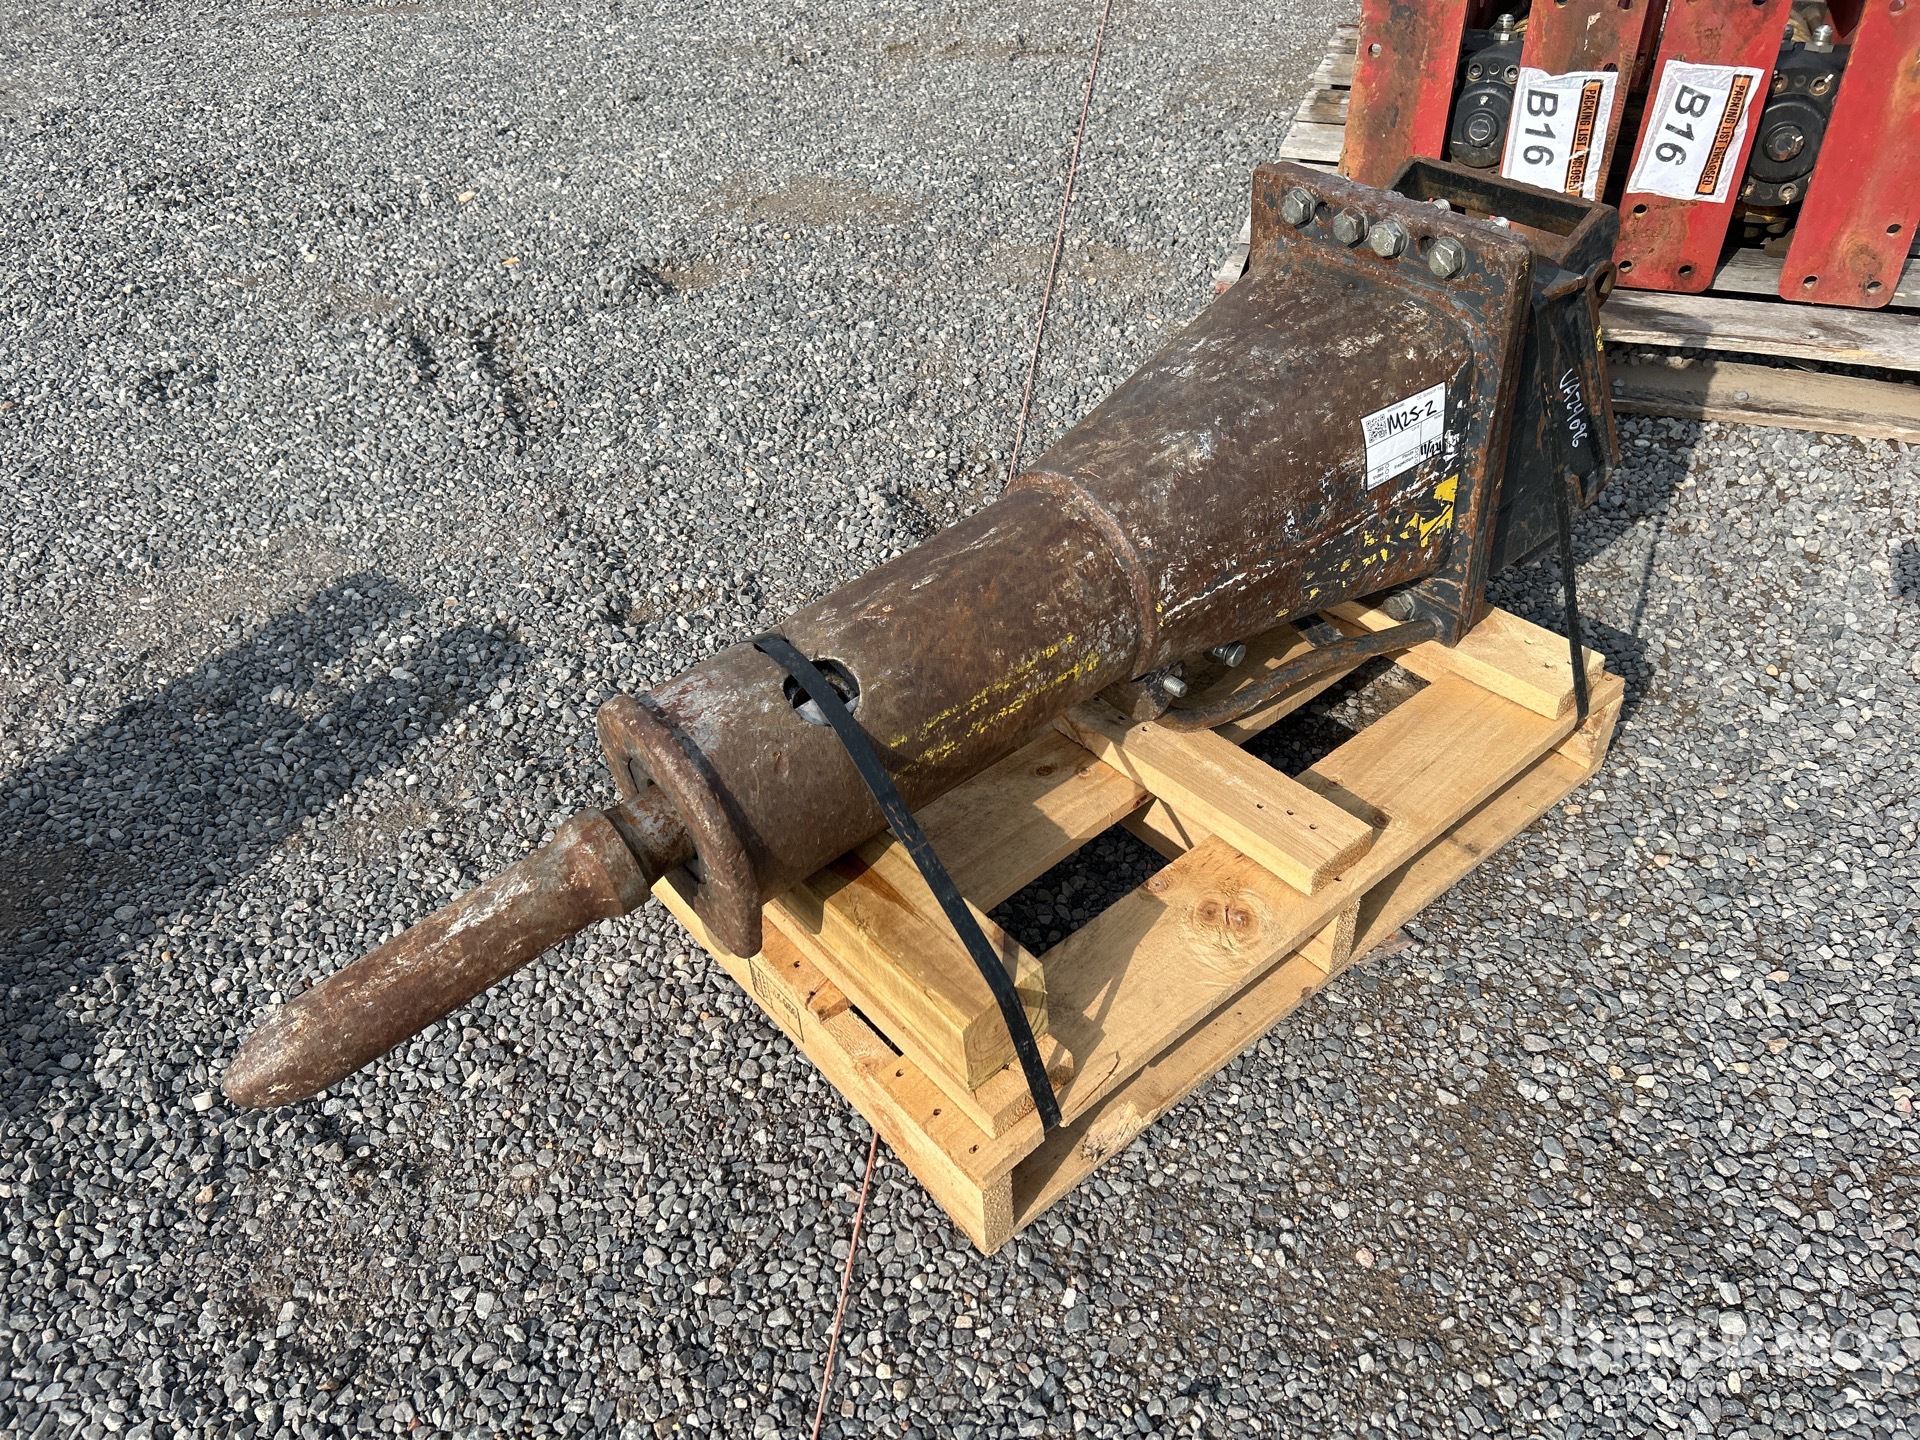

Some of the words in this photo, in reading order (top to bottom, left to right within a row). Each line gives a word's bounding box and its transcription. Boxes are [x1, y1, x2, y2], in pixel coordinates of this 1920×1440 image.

[1580, 89, 1597, 126] PACKING
[1725, 85, 1745, 124] PACKING
[1523, 89, 1558, 166] B16
[1576, 128, 1589, 146] LIST
[1655, 84, 1711, 165] B16
[1719, 126, 1733, 143] LIST
